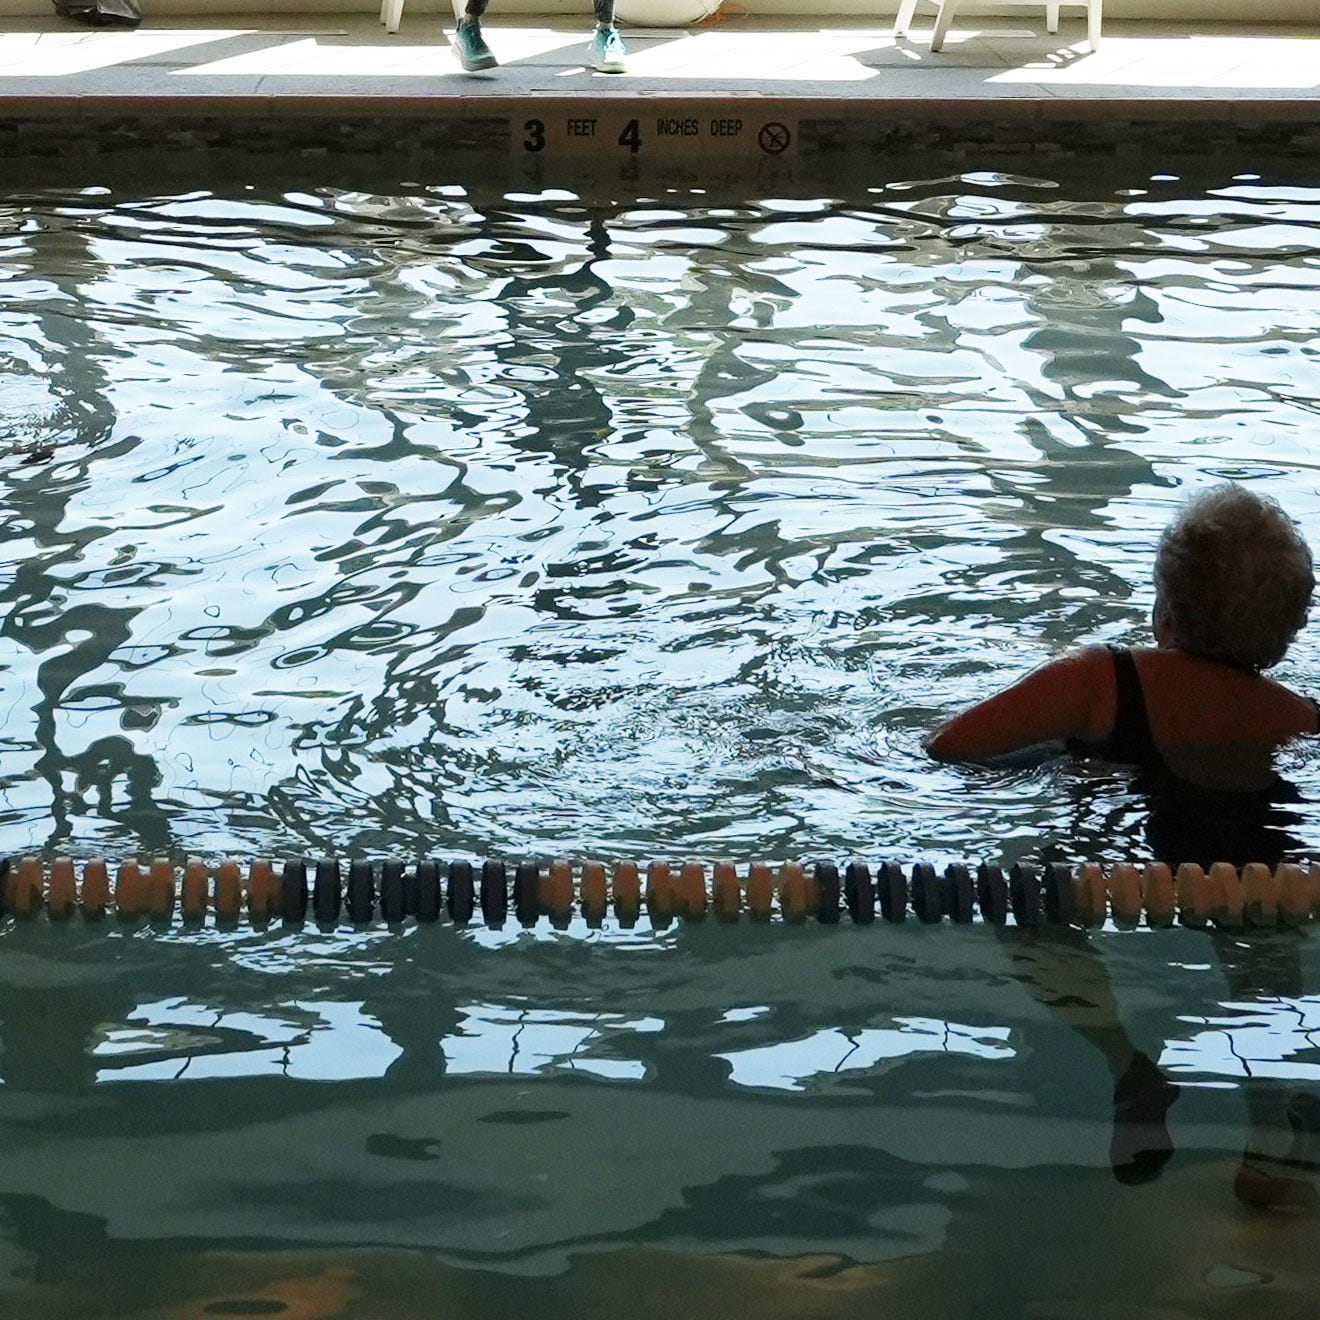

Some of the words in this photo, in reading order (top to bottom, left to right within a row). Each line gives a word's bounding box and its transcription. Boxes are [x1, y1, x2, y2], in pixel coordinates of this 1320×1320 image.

[523, 118, 546, 153] 3
[567, 118, 597, 136] FEET
[618, 118, 642, 153] 4
[657, 118, 699, 137] INCHES
[710, 118, 743, 137] DEEP
